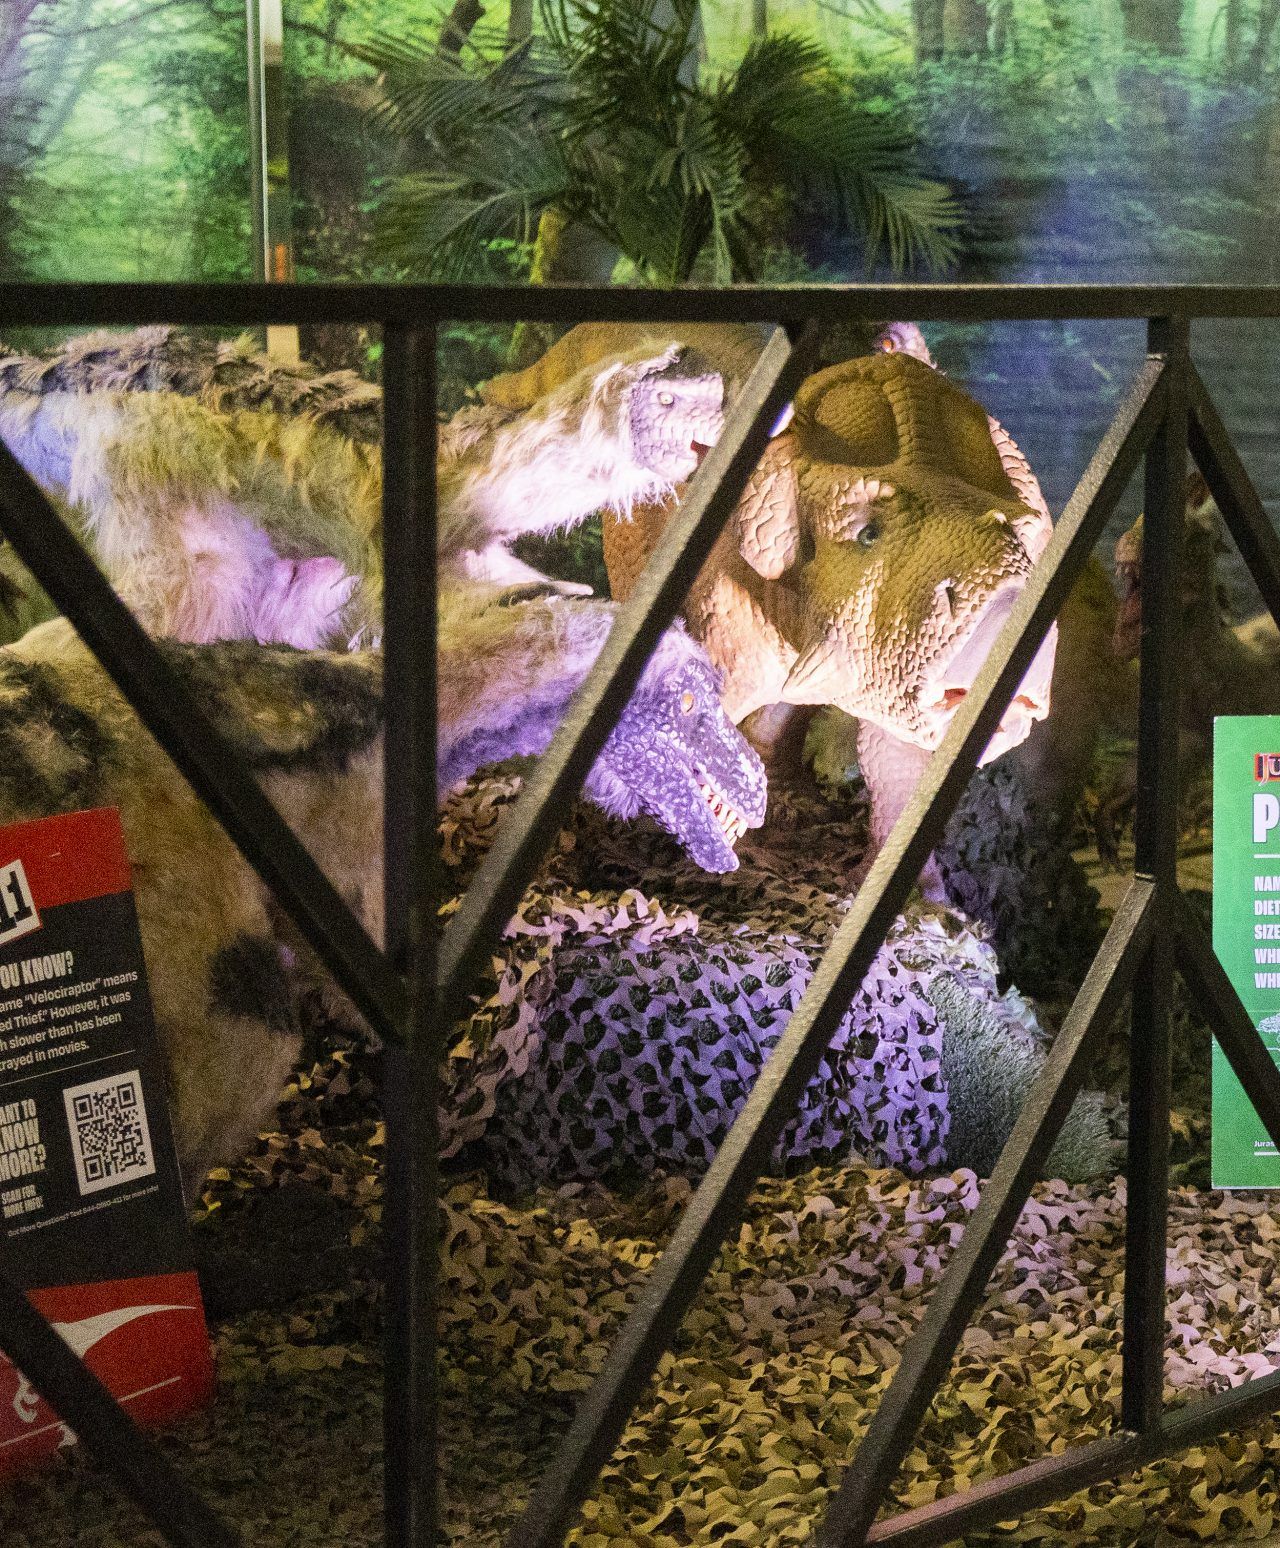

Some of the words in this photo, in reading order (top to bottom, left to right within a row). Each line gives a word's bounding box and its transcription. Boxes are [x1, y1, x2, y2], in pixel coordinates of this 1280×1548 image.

[0, 962, 20, 989] OU
[21, 950, 74, 985] KNOW?
[0, 998, 23, 1013] ame
[103, 970, 138, 988] means
[50, 998, 100, 1020] However,
[100, 994, 109, 1008] it
[110, 991, 132, 1004] was
[9, 1031, 47, 1049] slower
[48, 1024, 74, 1039] than
[74, 1020, 95, 1033] has
[95, 1012, 122, 1027] been
[34, 1050, 46, 1062] in
[47, 1040, 90, 1059] movies.
[0, 1101, 20, 1126] ANT
[21, 1098, 37, 1119] TO
[1, 1188, 22, 1205] SCAN
